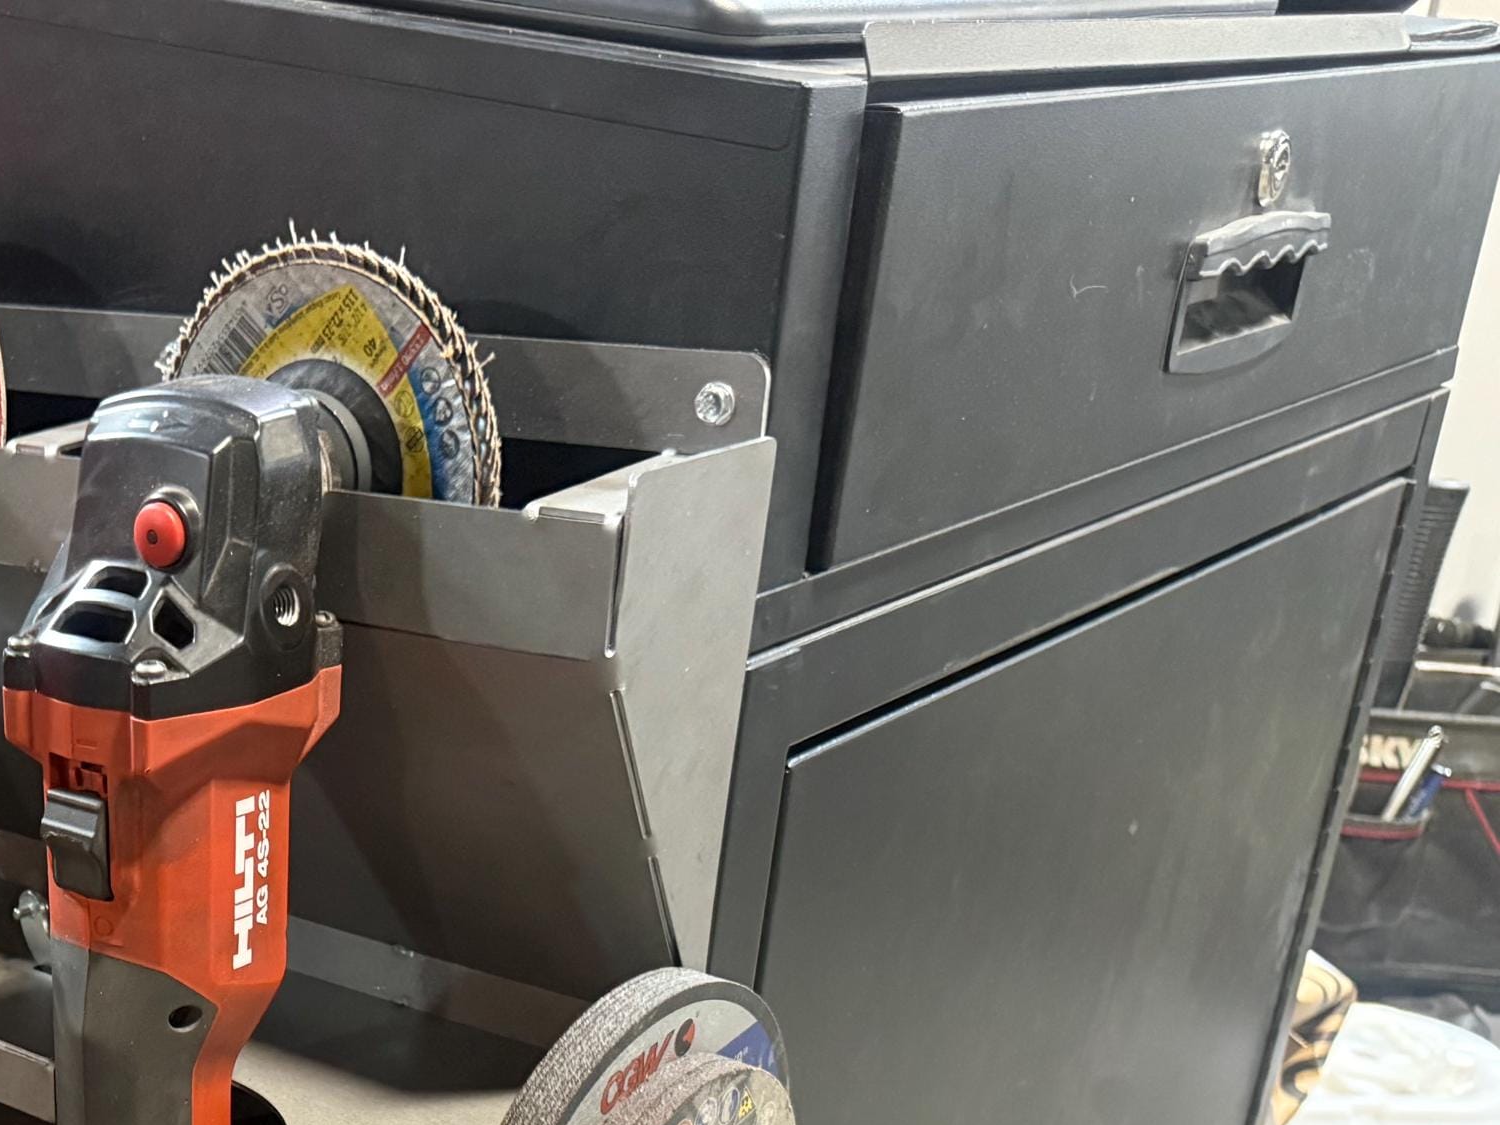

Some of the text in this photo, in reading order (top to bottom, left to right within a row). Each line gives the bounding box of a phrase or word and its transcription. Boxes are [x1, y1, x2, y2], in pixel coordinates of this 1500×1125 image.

[233, 796, 255, 970] HILTI
[256, 789, 270, 925] AG 4S-22
